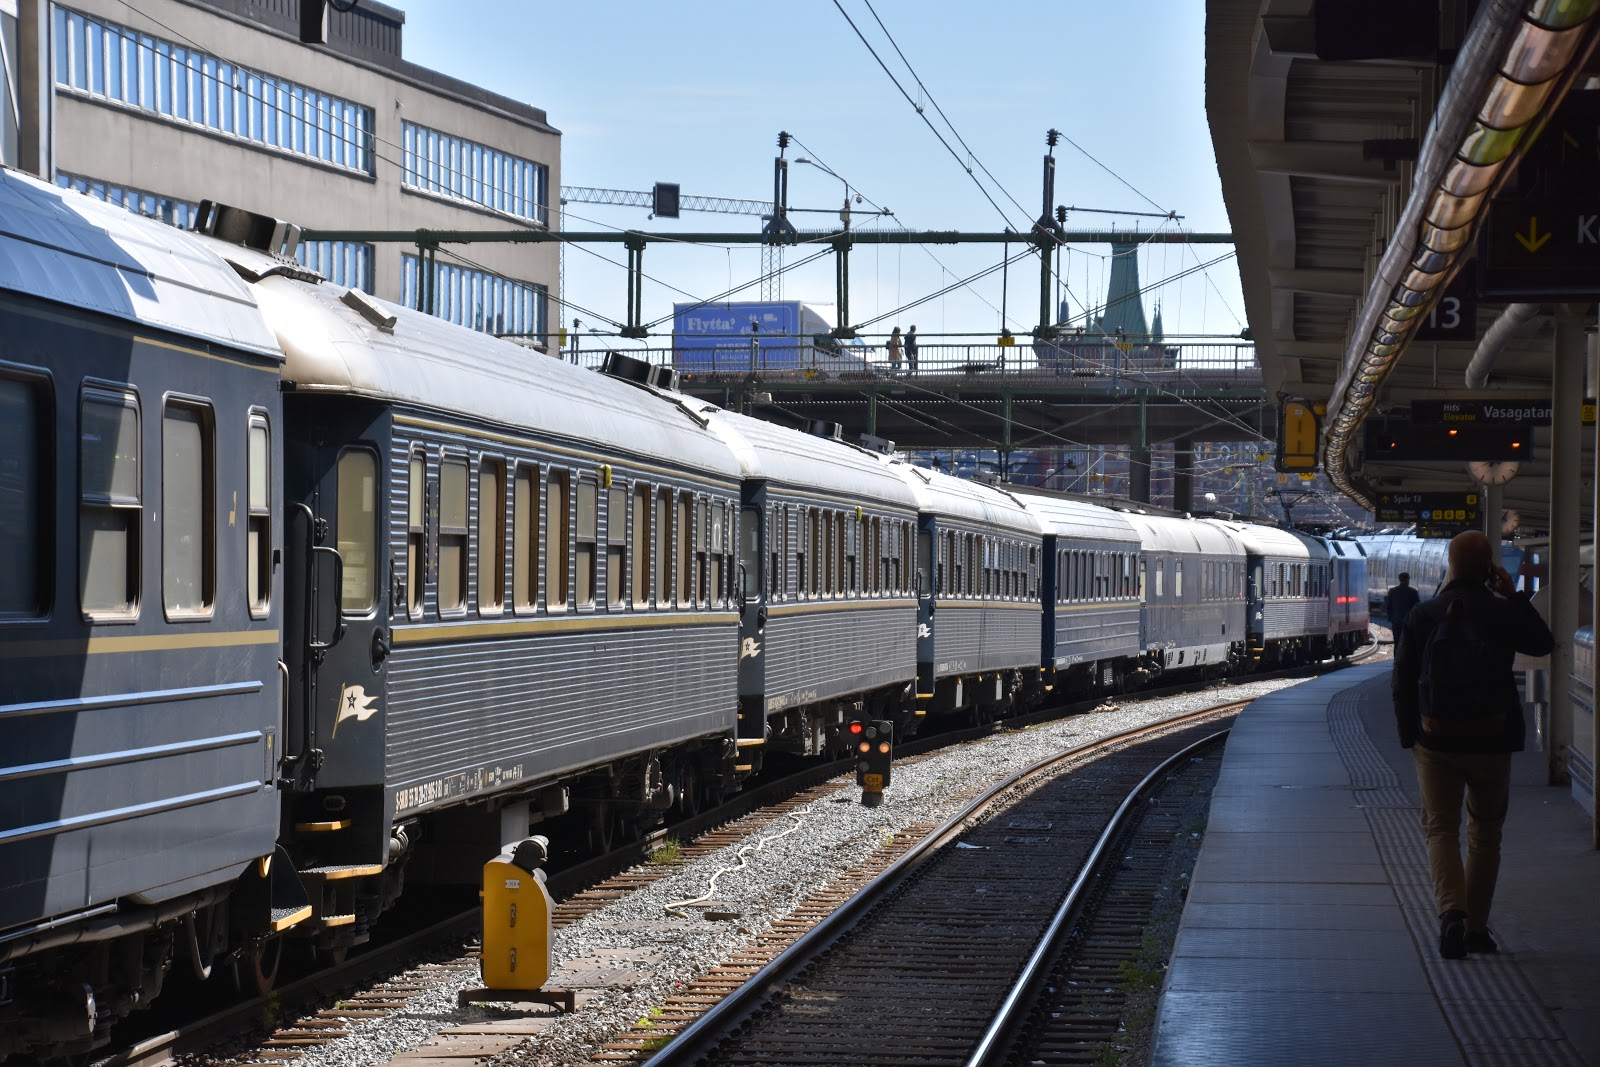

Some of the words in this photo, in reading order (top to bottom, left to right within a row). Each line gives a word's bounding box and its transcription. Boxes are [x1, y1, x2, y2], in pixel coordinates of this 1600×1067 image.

[1577, 214, 1600, 244] K
[687, 317, 736, 334] Flytta?
[1443, 404, 1460, 412] Hiss
[1484, 405, 1553, 421] Vasagatan
[1443, 413, 1476, 421] Elevator
[1393, 494, 1411, 504] Spår
[1413, 495, 1422, 503] 13
